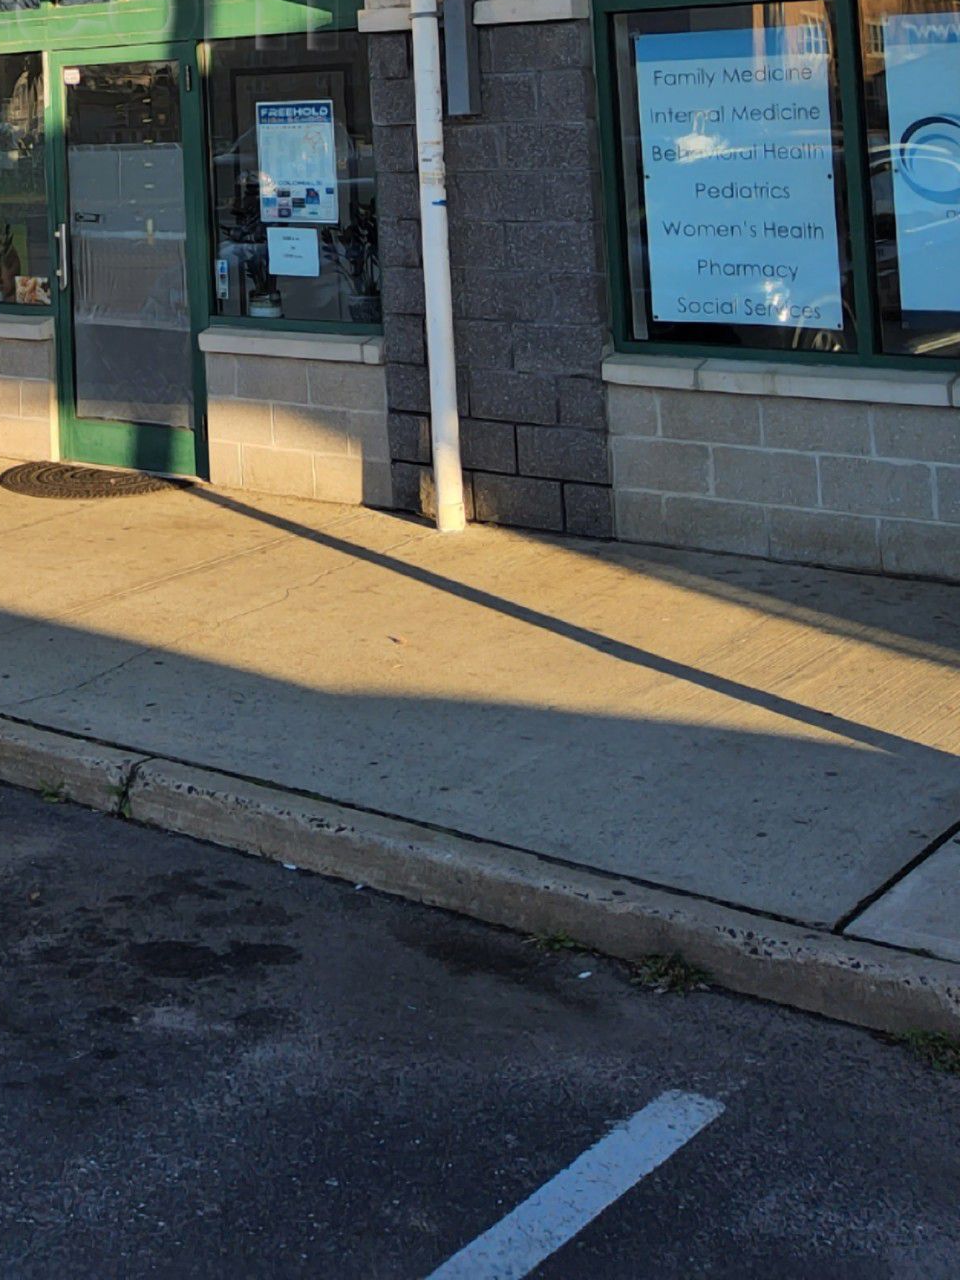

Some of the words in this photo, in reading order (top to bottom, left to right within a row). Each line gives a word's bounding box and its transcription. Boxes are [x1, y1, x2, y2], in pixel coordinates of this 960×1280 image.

[653, 68, 716, 88] Family
[722, 64, 813, 83] Medicine
[650, 105, 724, 124] Internal
[731, 102, 821, 122] Medicine
[763, 143, 825, 161] Health
[695, 181, 791, 199] Pediatrics
[662, 220, 757, 239] Women's
[763, 222, 825, 240] Health
[697, 259, 799, 281] Pharmacy
[677, 296, 737, 314] Social
[744, 298, 822, 320] Services
